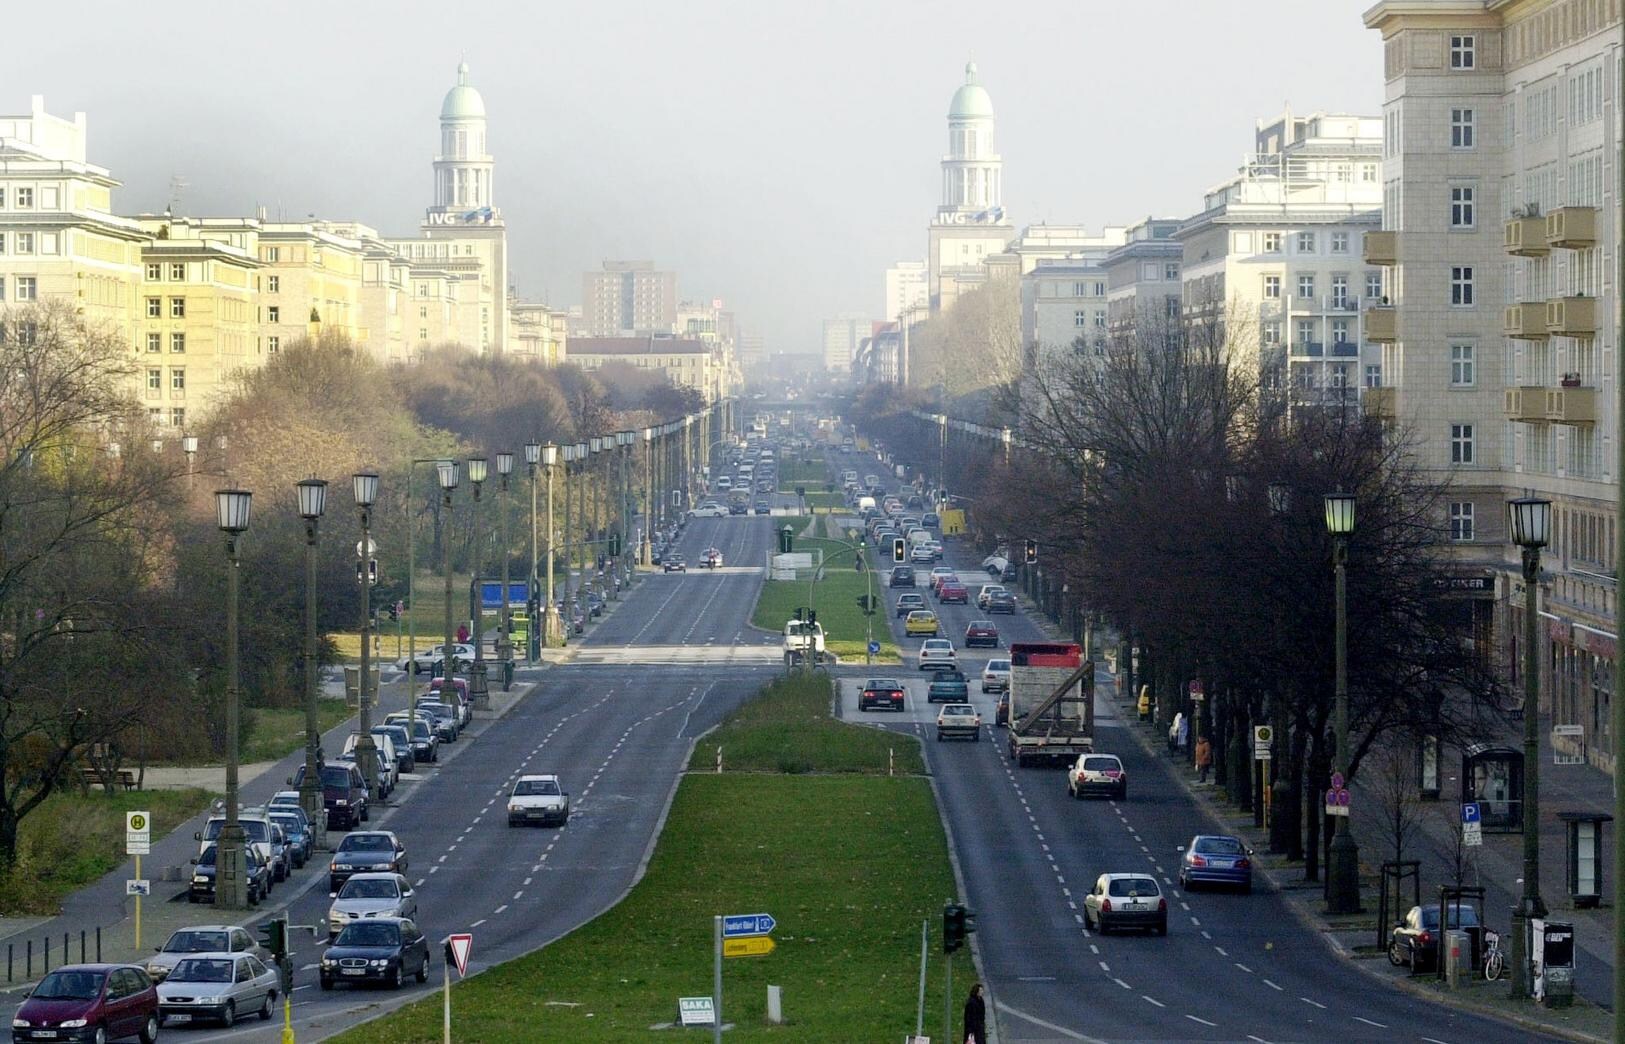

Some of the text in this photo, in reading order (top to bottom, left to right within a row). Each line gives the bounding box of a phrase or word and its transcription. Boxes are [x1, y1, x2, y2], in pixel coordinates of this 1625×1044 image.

[429, 213, 455, 224] IVG
[940, 212, 966, 224] IVG
[1465, 806, 1475, 821] P
